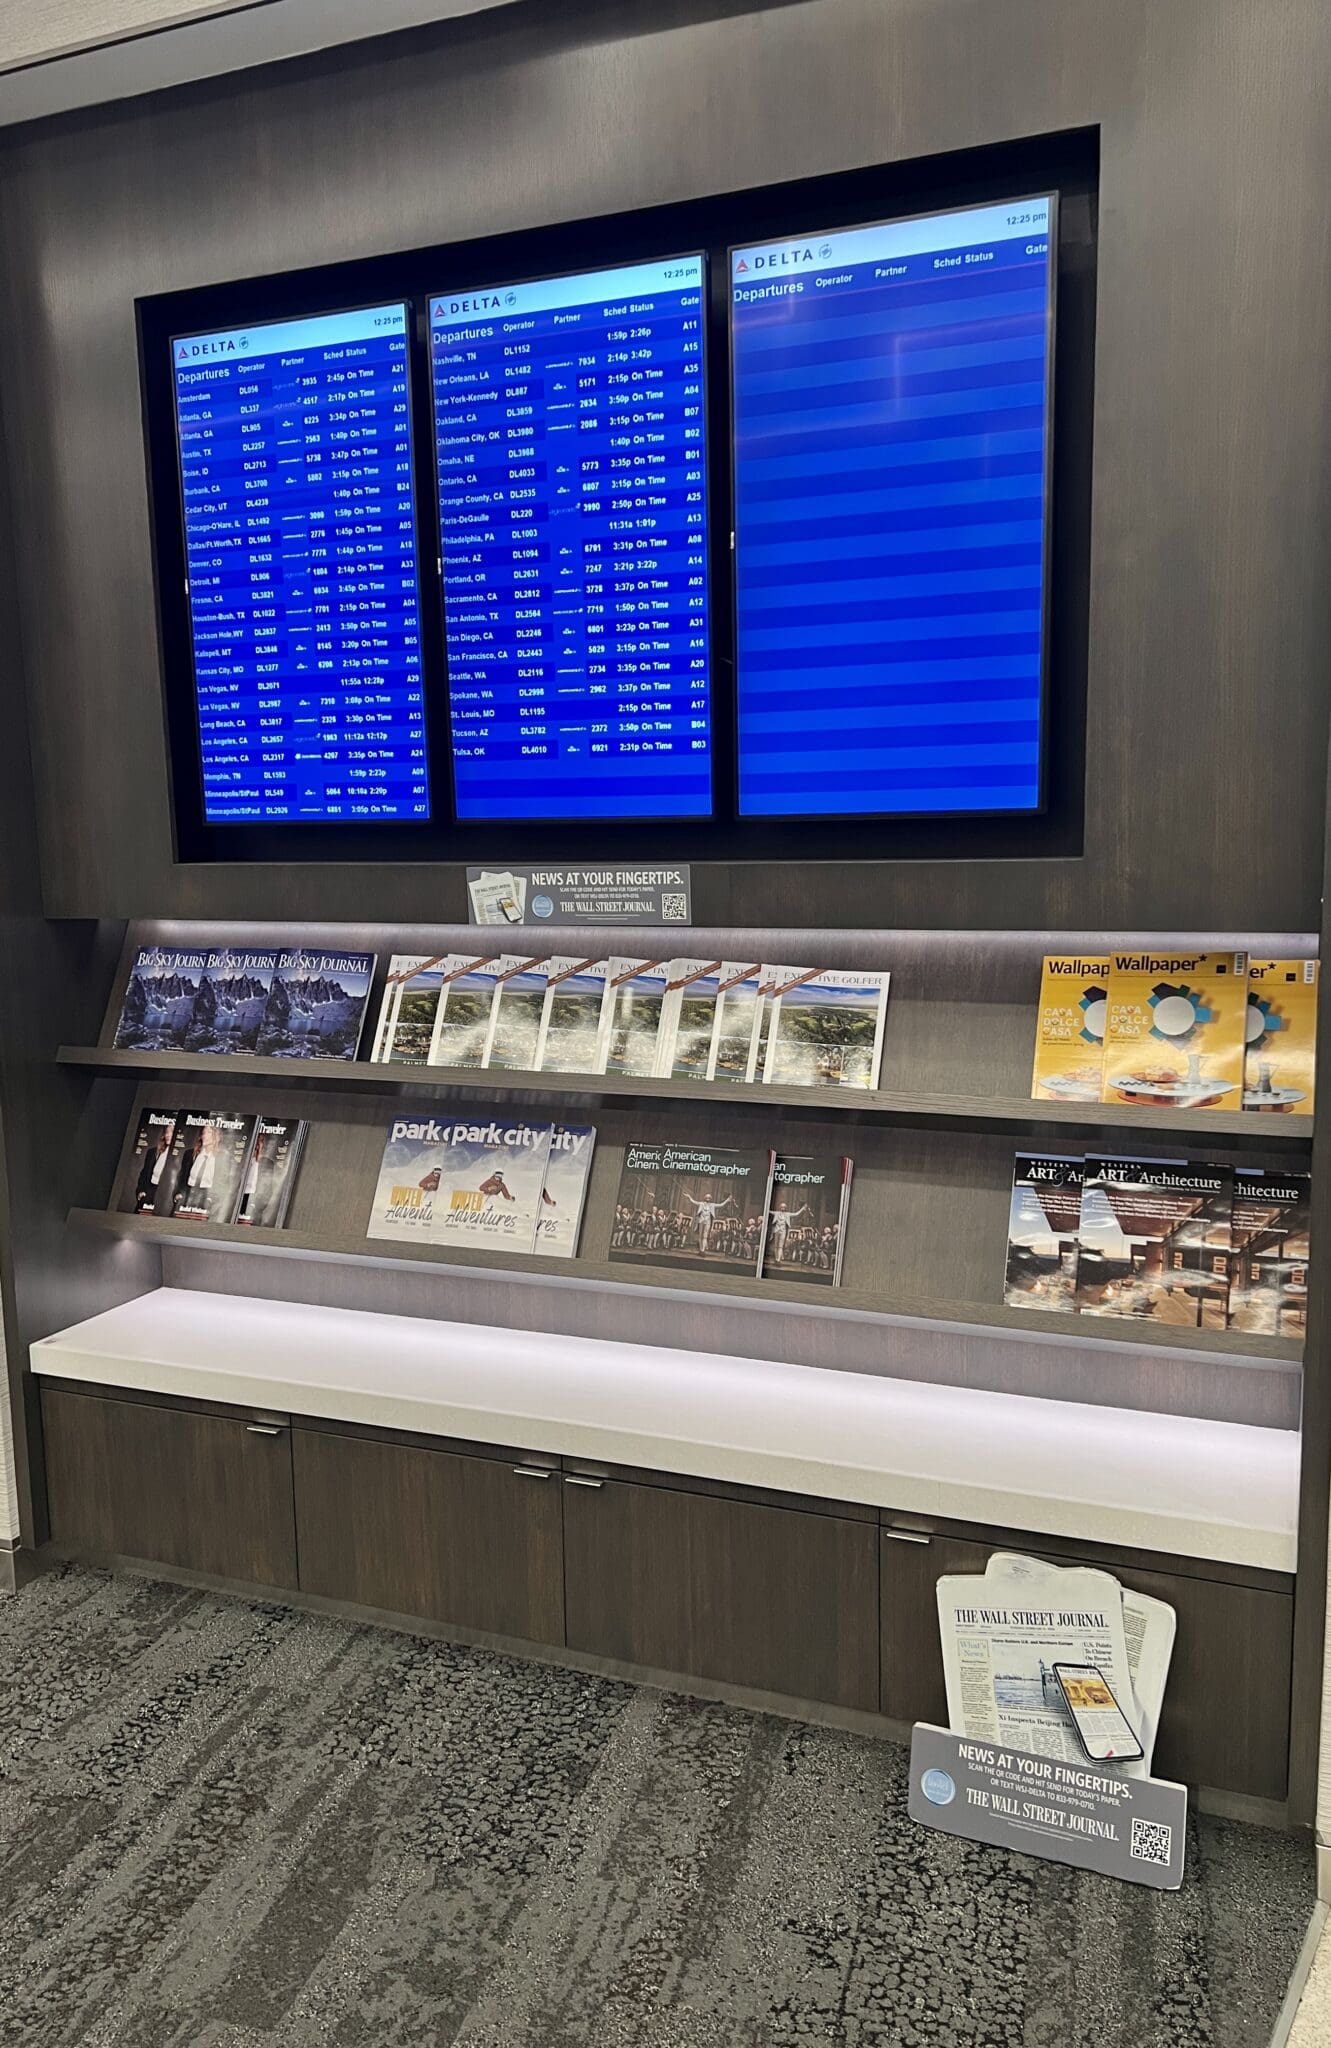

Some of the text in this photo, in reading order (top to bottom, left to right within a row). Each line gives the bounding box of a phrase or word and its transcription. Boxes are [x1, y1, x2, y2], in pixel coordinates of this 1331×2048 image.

[1006, 212, 1047, 225] 12:25 pm
[754, 249, 813, 269] DELTA
[664, 268, 698, 278] 12:25 pm
[733, 244, 1048, 302] Departures Operator Partner Sched Status Gate
[450, 296, 501, 314] DELTA
[374, 316, 403, 326] 12:25 pm
[433, 296, 700, 345] Departures Operator Partner Sched Status Gate
[191, 340, 236, 356] DELTA
[177, 342, 406, 385] Departures Operator Partner Sched Status Gate
[326, 363, 404, 383] 2:45p On Time A21
[608, 374, 629, 385] 2:15p
[631, 371, 643, 381] On
[645, 369, 664, 379] Time
[683, 363, 699, 374] A35
[436, 406, 699, 446] Oklahoma City, OK 3:15p On Time B07
[438, 476, 466, 486] Ontario,
[466, 474, 477, 483] CA
[610, 458, 632, 468] 3:35p
[633, 456, 645, 465] On
[647, 454, 666, 464] Time
[685, 449, 700, 460] B01
[452, 748, 473, 756] Tulsa,
[474, 747, 485, 756] OK
[521, 745, 547, 754] DL4010
[619, 743, 640, 752] 2:31p
[642, 742, 653, 751] On
[655, 741, 673, 750] Time
[532, 871, 684, 886] NEWS AT YOUR FINGERTIPS.
[560, 901, 575, 912] THE
[576, 901, 595, 912] WALL
[595, 901, 622, 912] STREET
[137, 952, 155, 966] BIG
[154, 952, 175, 967] SKY
[207, 953, 225, 968] BIG
[223, 954, 245, 970] SKY
[278, 953, 369, 974] BIG SKY JOURNAL
[841, 975, 883, 986] GOLFER
[1044, 1008, 1073, 1017] CASA
[1111, 1005, 1142, 1015] CASA
[1043, 1017, 1080, 1027] DOLCE
[1110, 1015, 1149, 1025] DOLCE
[1042, 1027, 1072, 1036] CASA
[1110, 1025, 1140, 1034] CASA
[185, 1115, 245, 1130] Business Traveler
[259, 1122, 287, 1135] Traveler
[390, 1120, 441, 1143] park
[451, 1123, 547, 1151] park city
[663, 1148, 712, 1162] American
[662, 1158, 751, 1177] Cinematographer
[1030, 1160, 1071, 1169] WESTERN
[1100, 1162, 1142, 1170] WESTERN
[1026, 1167, 1057, 1180] ART
[1096, 1168, 1127, 1181] ART
[1138, 1171, 1223, 1190] Architecture
[444, 1204, 518, 1228] Adventures
[954, 1609, 979, 1624] THE
[979, 1610, 1011, 1625] WALL
[1011, 1611, 1055, 1627] STREET
[958, 1743, 1133, 1799] NEWS AT YOUR FINGERTIPS.
[967, 1762, 983, 1772] SCAN
[984, 1766, 996, 1775] THE
[995, 1769, 1005, 1778] QR
[1005, 1772, 1021, 1782] CODE
[1021, 1775, 1034, 1785] AND
[1035, 1778, 1046, 1788] HIT
[1046, 1781, 1062, 1792] SEND
[1062, 1785, 1075, 1795] FOR
[1075, 1788, 1100, 1802] TODAY'S
[990, 1777, 1000, 1786] OR
[1000, 1780, 1015, 1790] TEXT
[1015, 1783, 1047, 1798] WSJ-DELTA
[1047, 1791, 1056, 1801] TO
[966, 1787, 989, 1808] THE
[991, 1793, 1021, 1816] WALL
[1022, 1802, 1066, 1827] STREET
